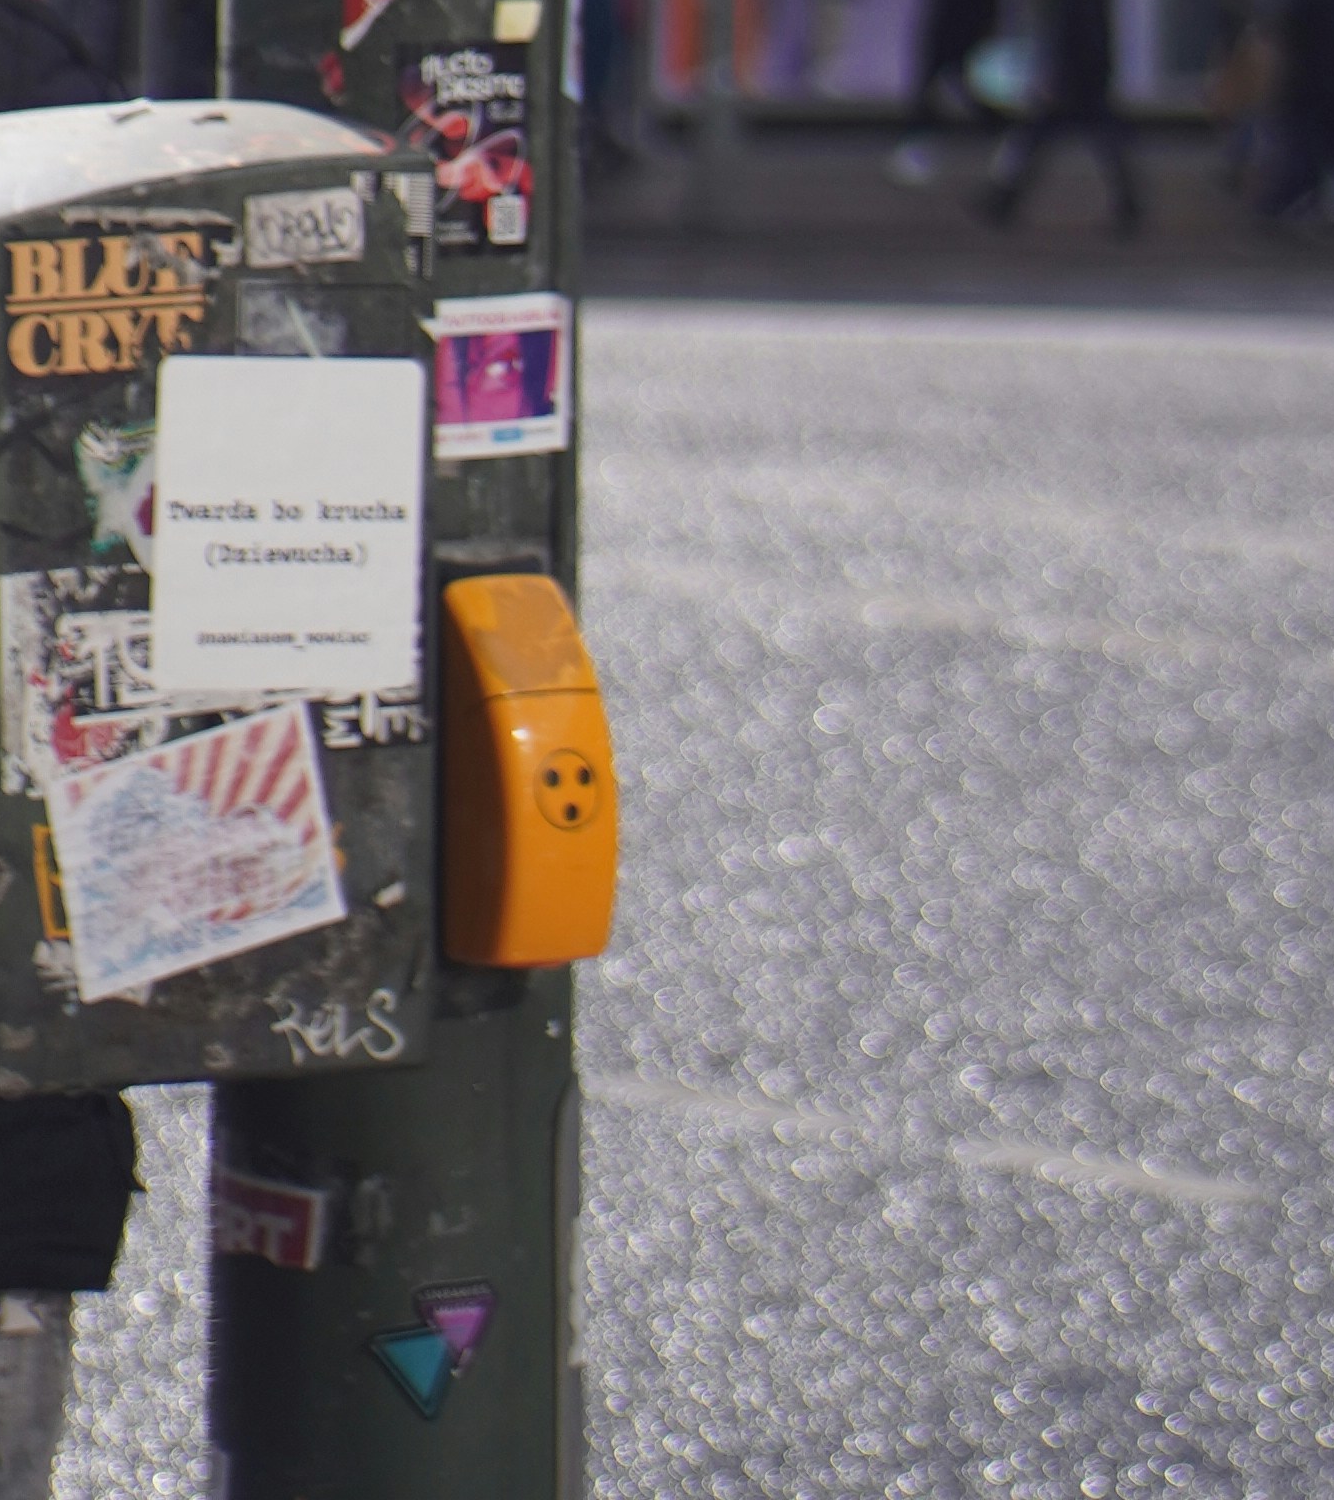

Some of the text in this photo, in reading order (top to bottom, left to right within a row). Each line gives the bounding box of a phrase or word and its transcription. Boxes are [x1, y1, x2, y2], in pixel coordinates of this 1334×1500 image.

[168, 499, 406, 521] Twarda bo krucha
[204, 543, 368, 568] (Dziewucha)
